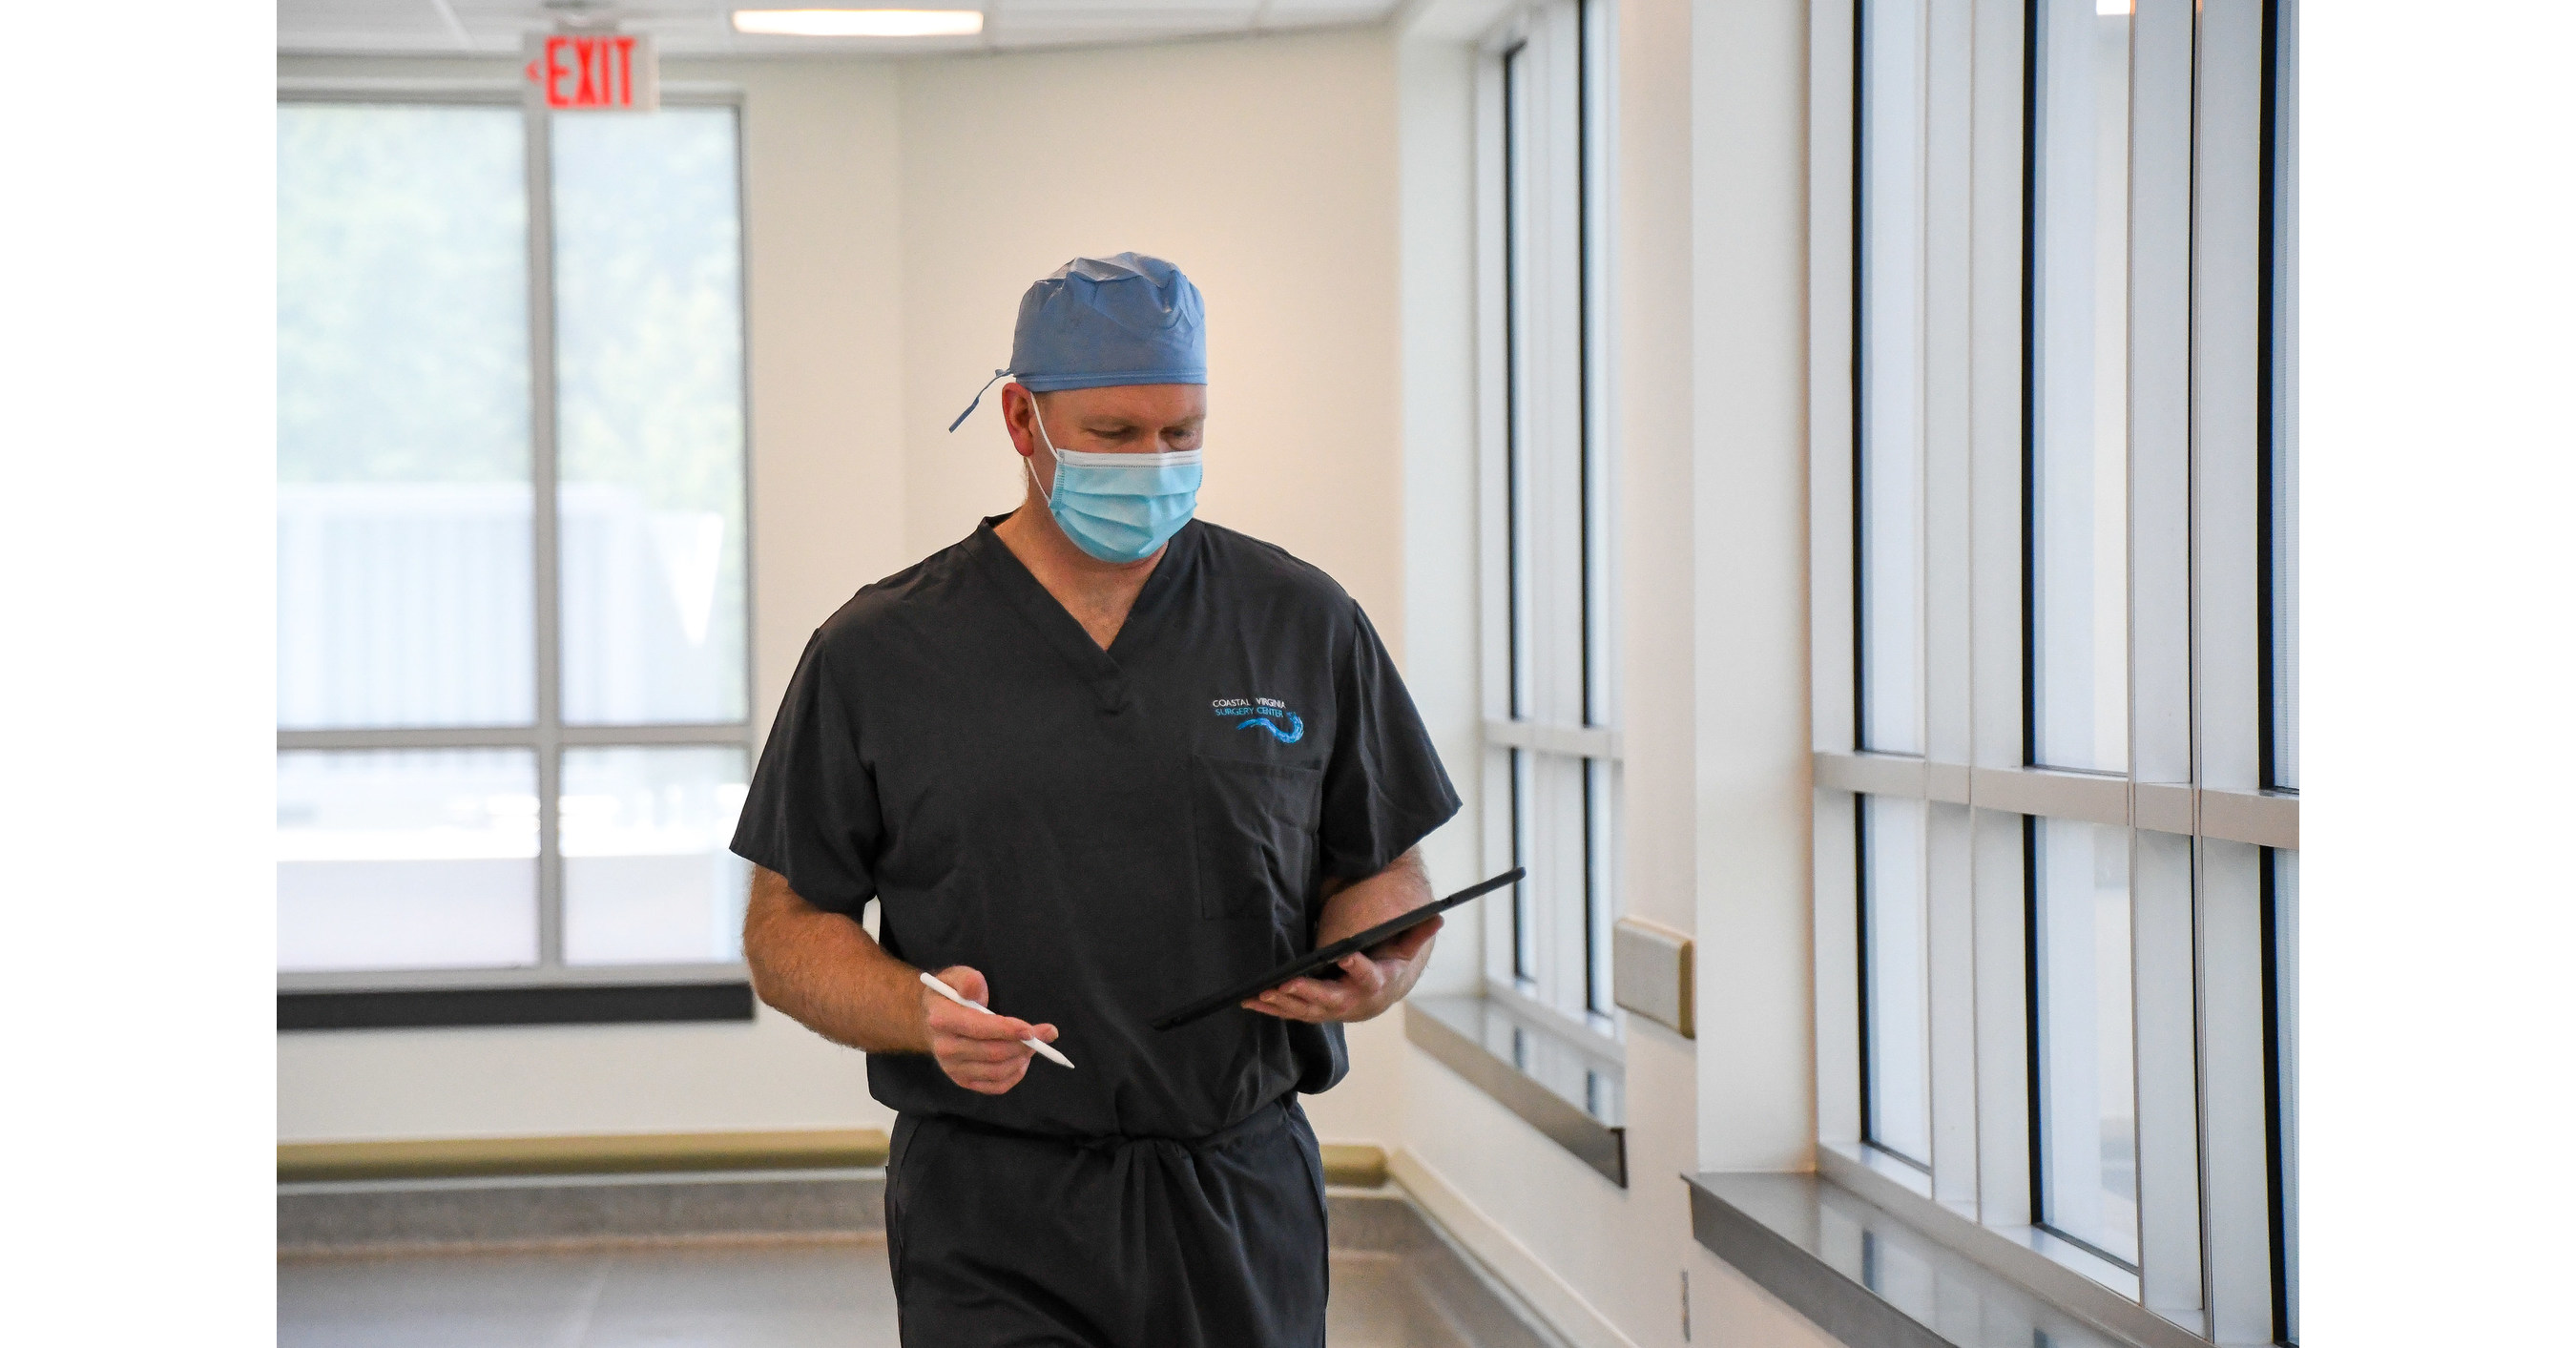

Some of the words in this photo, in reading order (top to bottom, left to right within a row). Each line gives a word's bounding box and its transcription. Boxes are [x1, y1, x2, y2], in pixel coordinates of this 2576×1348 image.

[545, 35, 636, 110] EXIT
[1212, 698, 1251, 708] COASTAL
[1256, 697, 1286, 709] VIRGINIA
[1215, 707, 1255, 716] SURGERY
[1256, 706, 1283, 717] CENTER
